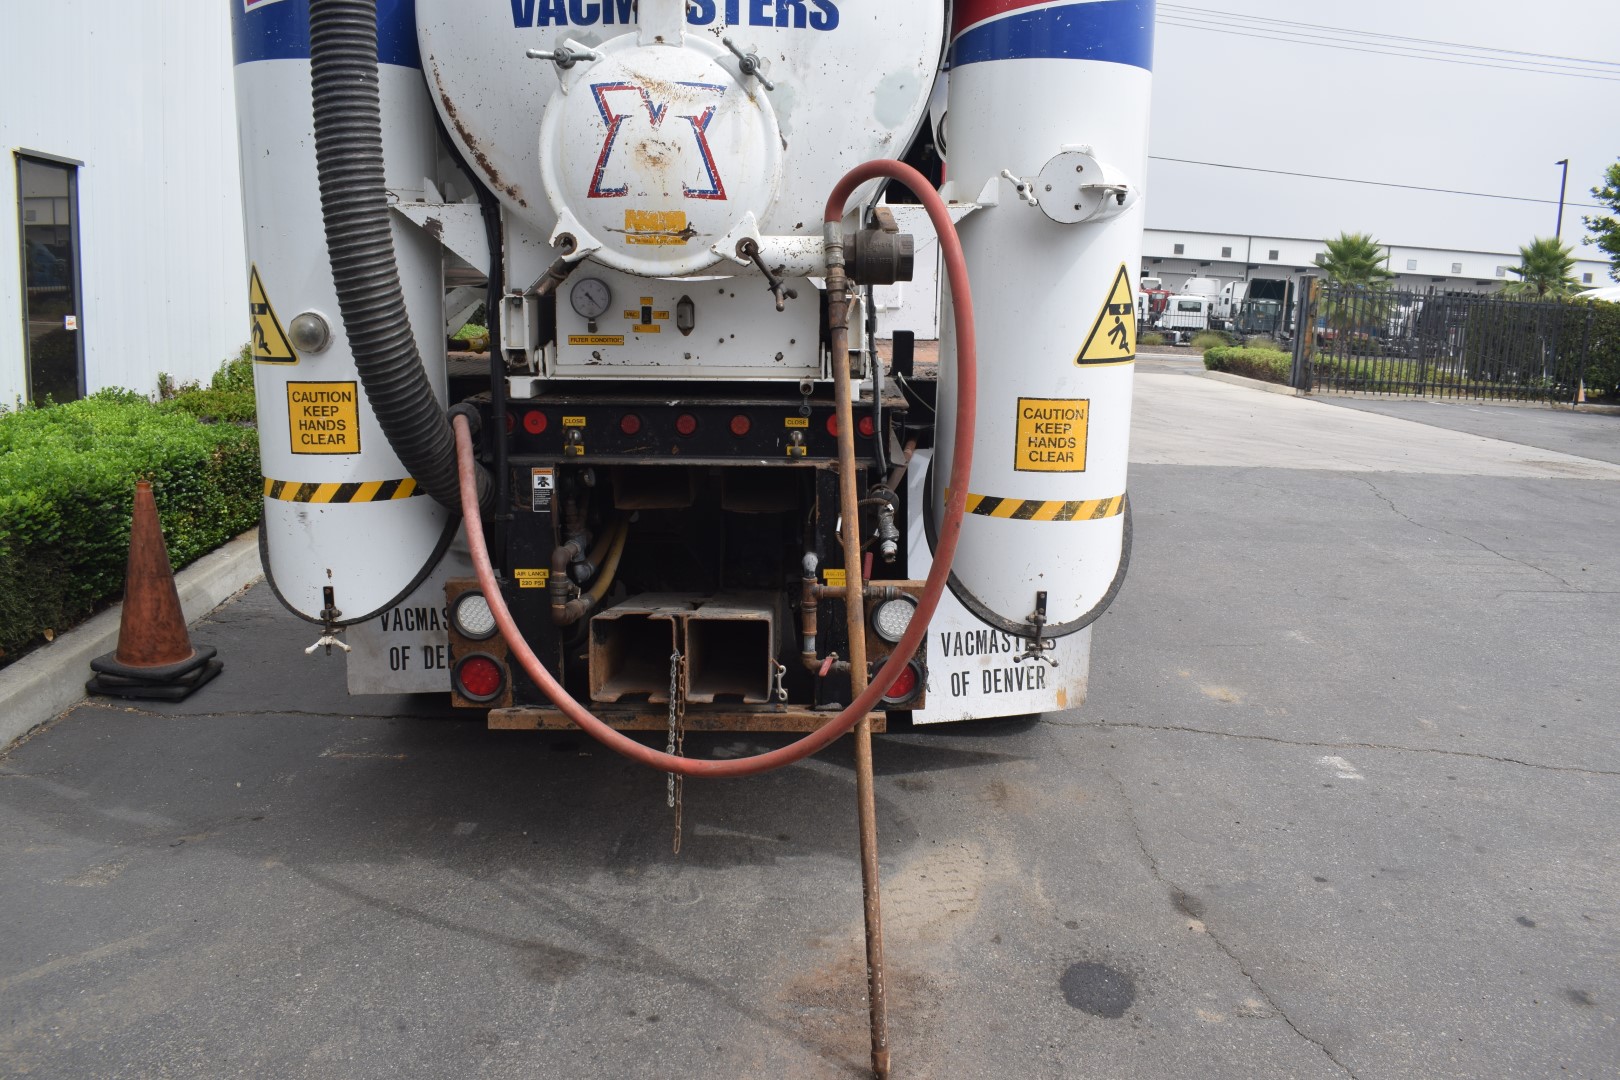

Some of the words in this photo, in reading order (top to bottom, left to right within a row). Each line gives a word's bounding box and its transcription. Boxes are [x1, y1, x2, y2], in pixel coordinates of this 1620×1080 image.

[292, 391, 352, 403] CAUTION
[303, 405, 339, 417] KEEP
[1023, 407, 1085, 420] CAUTION
[299, 419, 346, 431] HANDS
[1034, 422, 1072, 434] KEEP
[301, 433, 346, 445] CLEAR
[1028, 436, 1076, 449] HANDS
[1028, 450, 1074, 463] CLEAR
[389, 645, 411, 671] OF
[950, 670, 970, 697] OF
[982, 665, 1046, 694] DENVER
